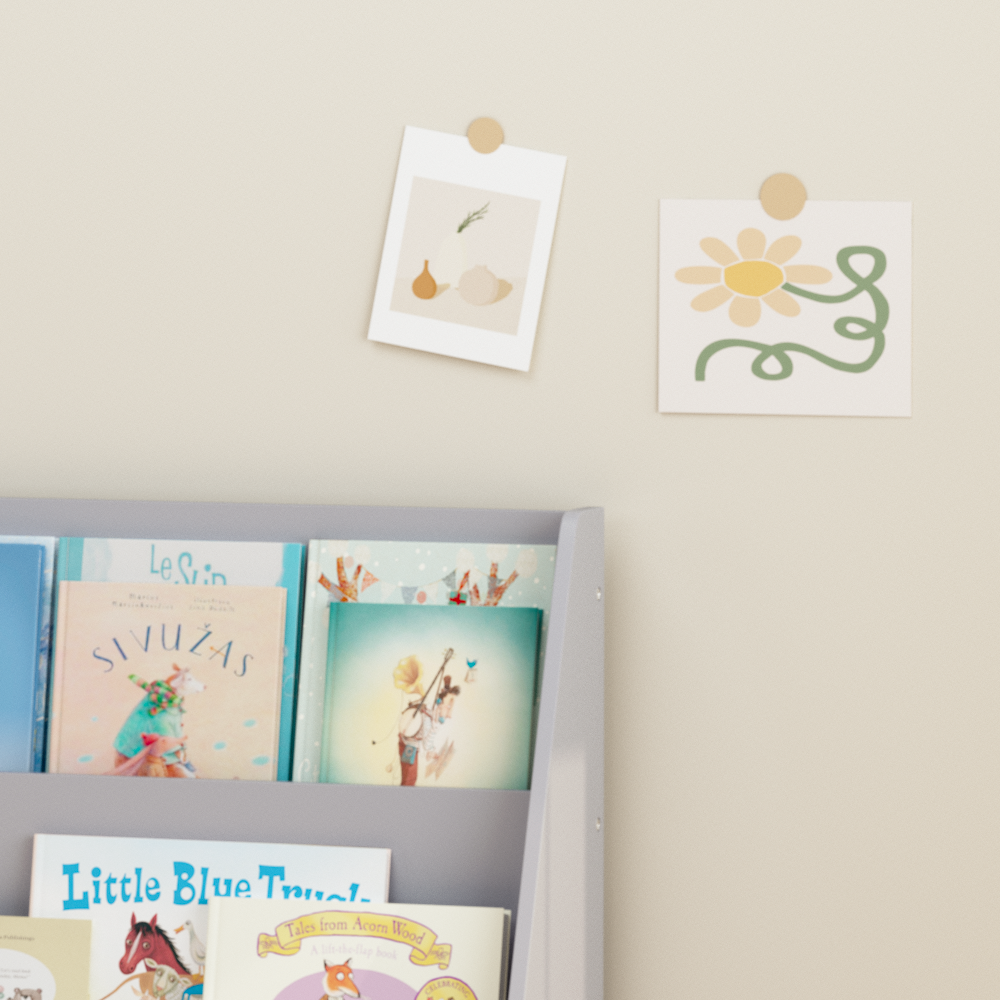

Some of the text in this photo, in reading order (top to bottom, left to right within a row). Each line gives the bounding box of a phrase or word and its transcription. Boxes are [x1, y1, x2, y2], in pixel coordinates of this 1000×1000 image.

[150, 543, 172, 581] Le
[92, 621, 254, 678] SIVUŽAS
[61, 863, 161, 911] Little
[173, 861, 251, 906] Blue
[284, 916, 426, 945] Tales from Acorn Wood
[310, 945, 398, 960] A lift-the-flap book
[425, 980, 470, 998] CELEBRATING
